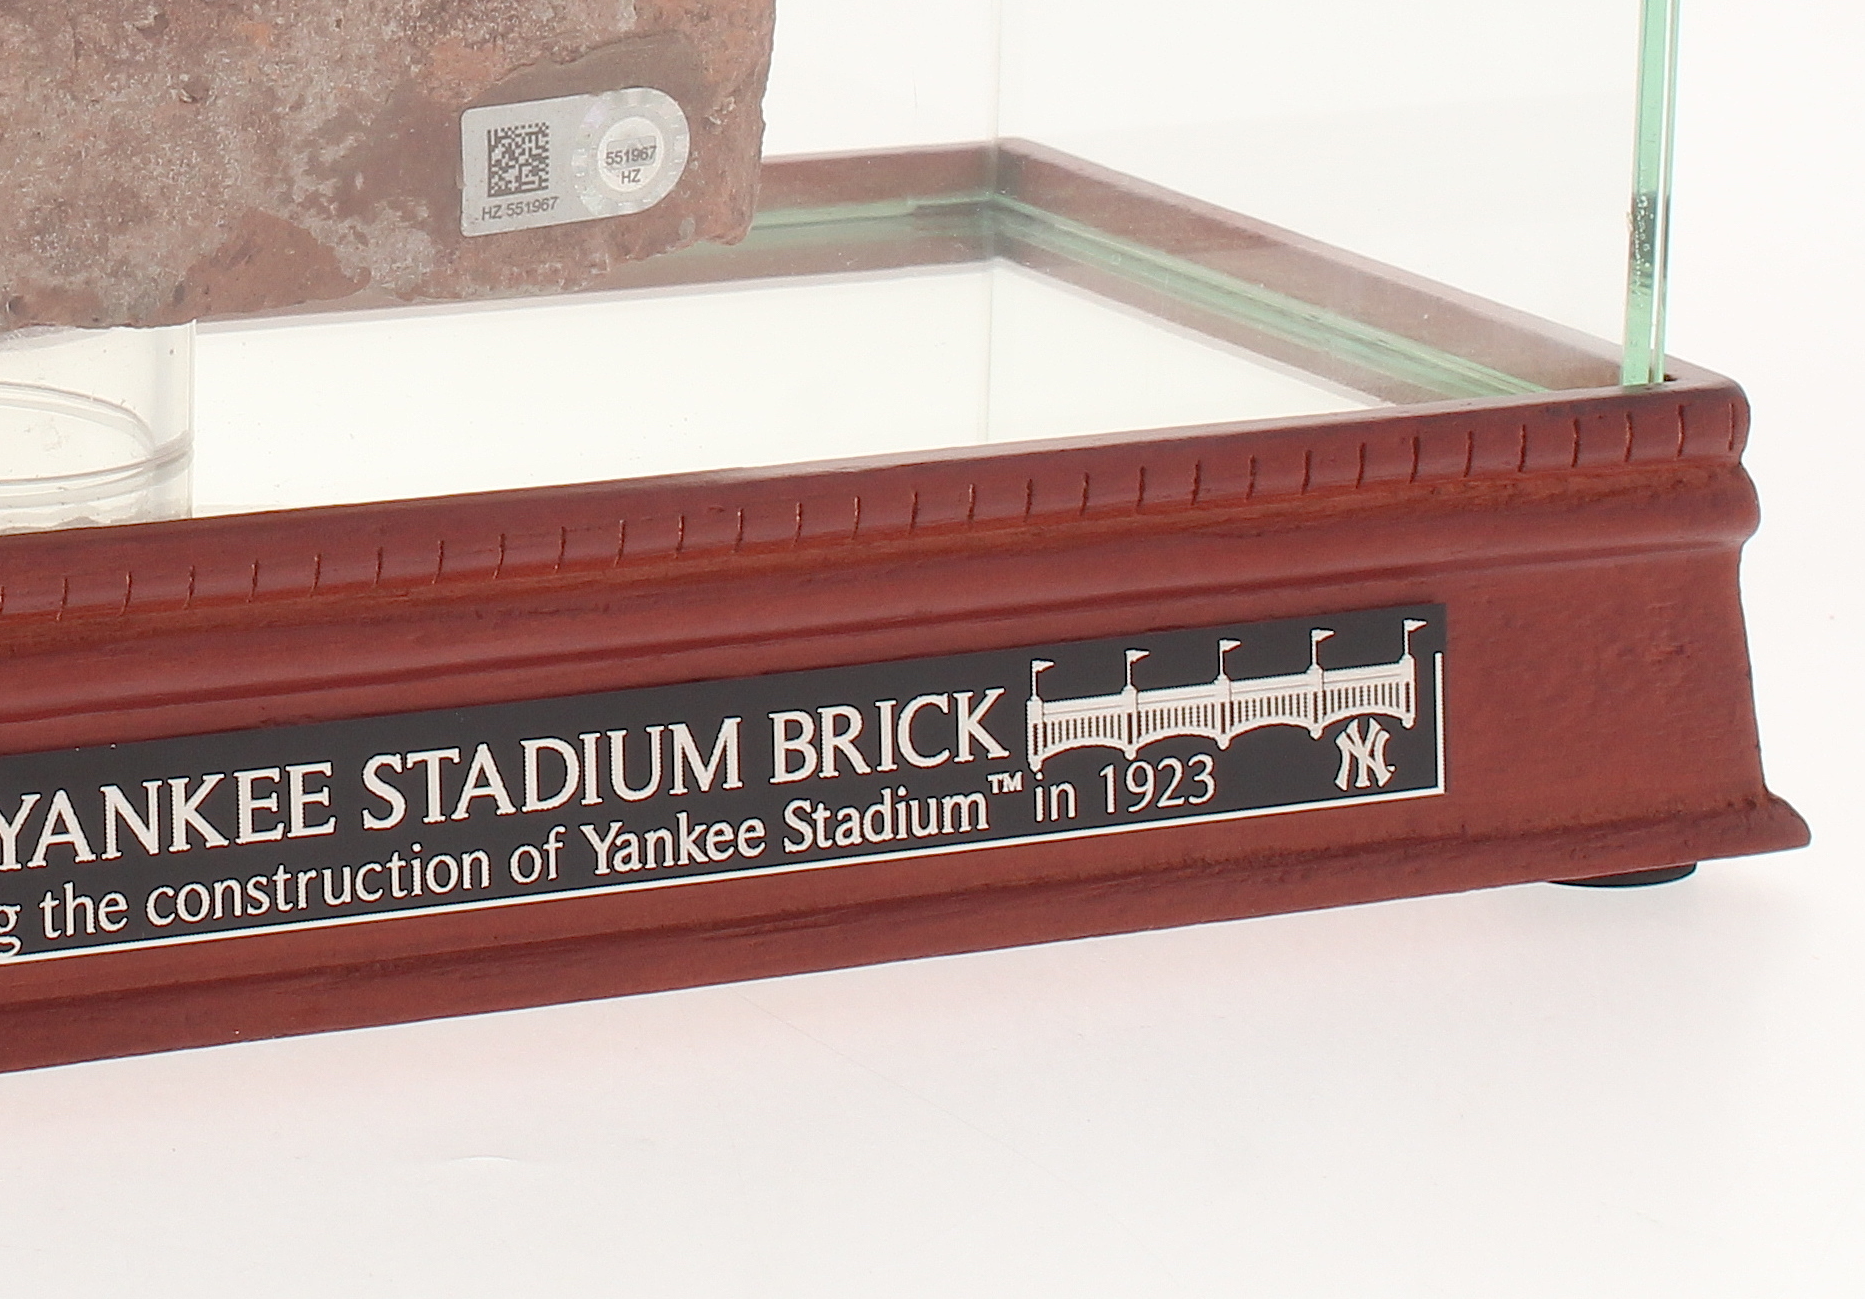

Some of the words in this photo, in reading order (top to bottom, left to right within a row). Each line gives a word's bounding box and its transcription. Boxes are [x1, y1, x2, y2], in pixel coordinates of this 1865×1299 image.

[605, 145, 656, 166] 551967
[621, 168, 641, 185] HZ
[481, 204, 502, 221] HZ
[506, 196, 559, 217] 551967
[363, 718, 742, 828] STADIUM
[769, 688, 1009, 782] BRICK
[1335, 717, 1395, 791] NY
[40, 882, 127, 938] the
[147, 844, 489, 925] construction
[511, 827, 565, 882] of
[580, 812, 765, 874] Yankee
[1036, 772, 1075, 821] in
[1100, 755, 1214, 812] 1923
